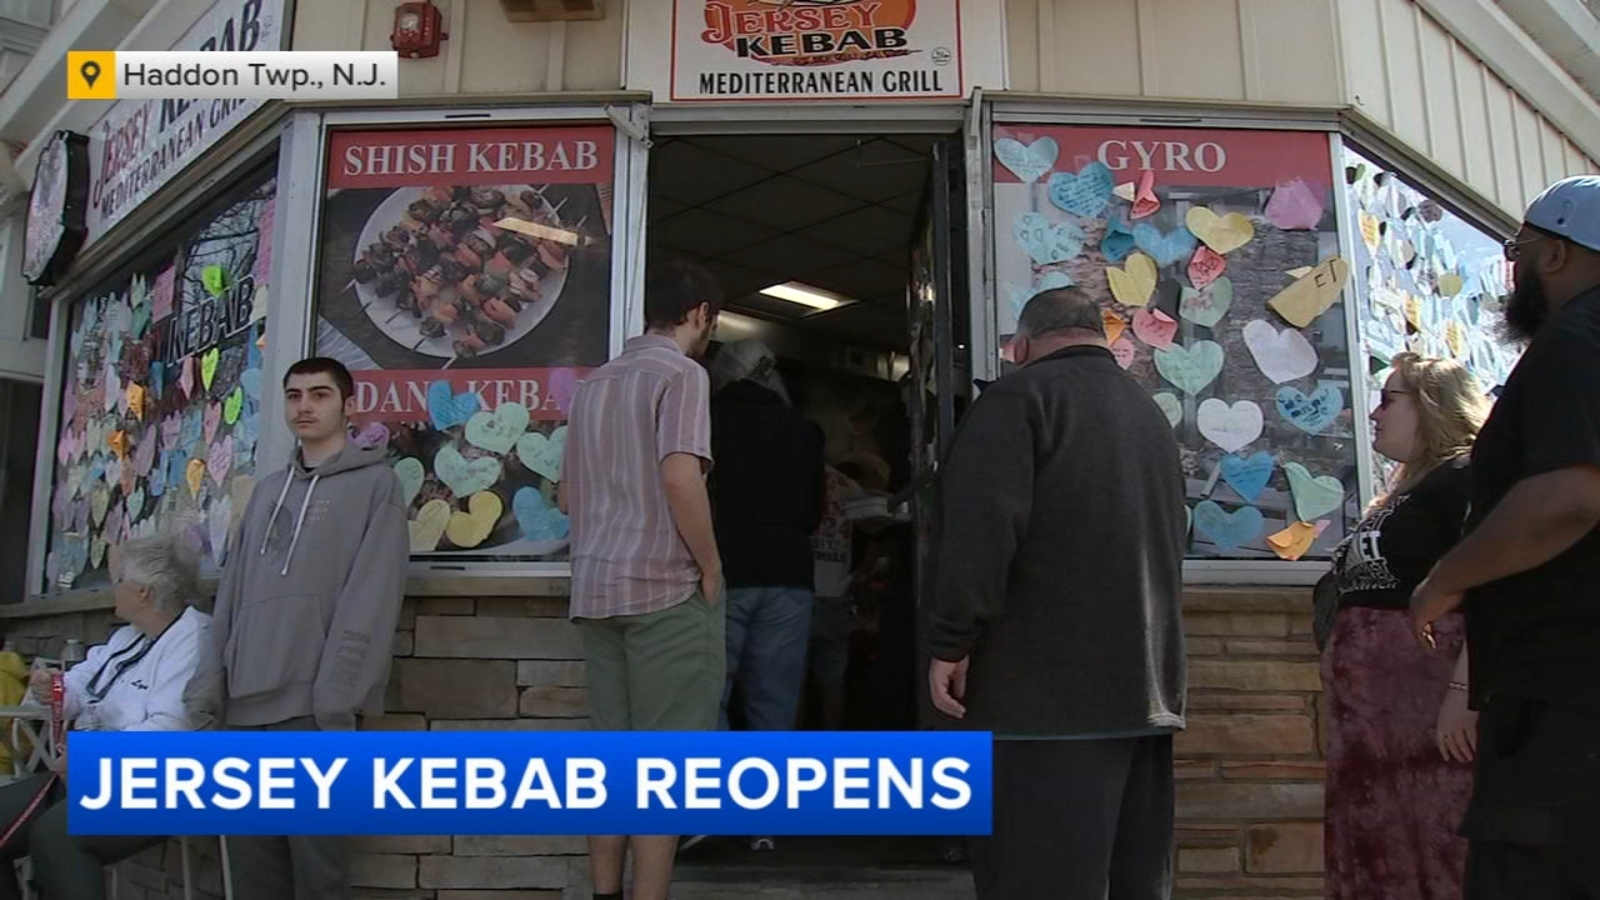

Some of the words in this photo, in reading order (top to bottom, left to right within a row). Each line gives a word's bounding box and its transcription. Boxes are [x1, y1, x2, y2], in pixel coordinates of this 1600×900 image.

[701, 3, 882, 44] JERSEY
[735, 28, 909, 58] KEBAB
[700, 71, 873, 95] MEDITERRANEAN
[882, 70, 943, 93] GRILL
[344, 143, 456, 176] SHISH
[467, 140, 599, 173] KEBAB
[1097, 139, 1226, 173] GYRO
